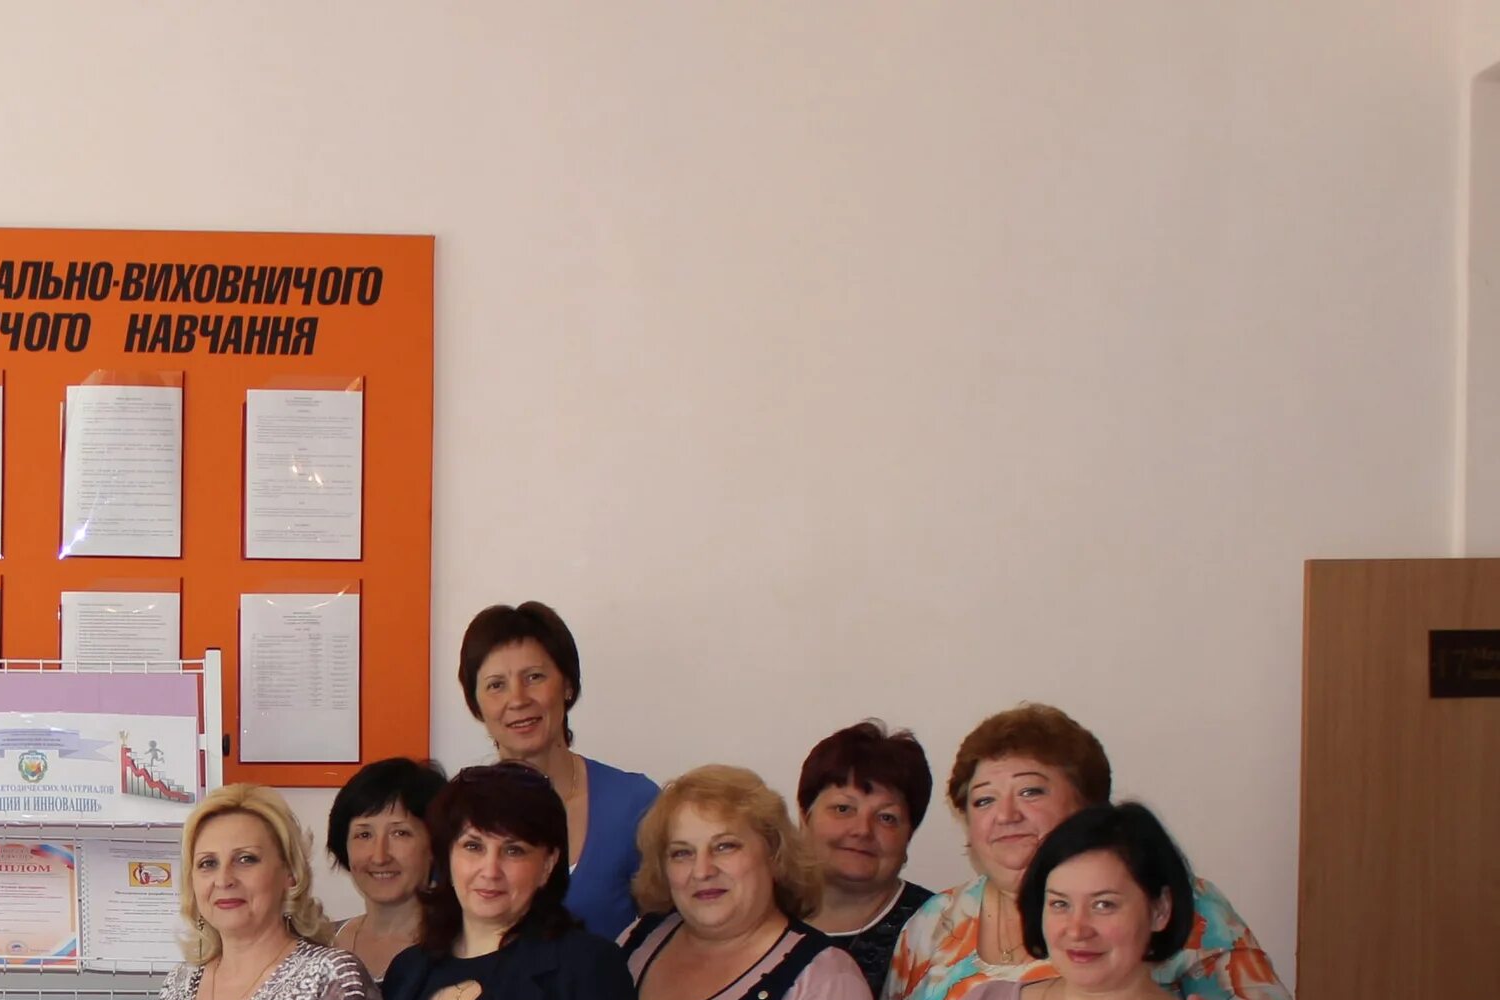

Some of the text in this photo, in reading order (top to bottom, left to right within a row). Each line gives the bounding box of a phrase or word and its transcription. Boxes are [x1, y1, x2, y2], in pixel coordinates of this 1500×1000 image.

[124, 313, 319, 356] НАВЧАННЯ
[62, 784, 115, 795] МАТЕРИАЛОВ
[23, 796, 31, 812] И
